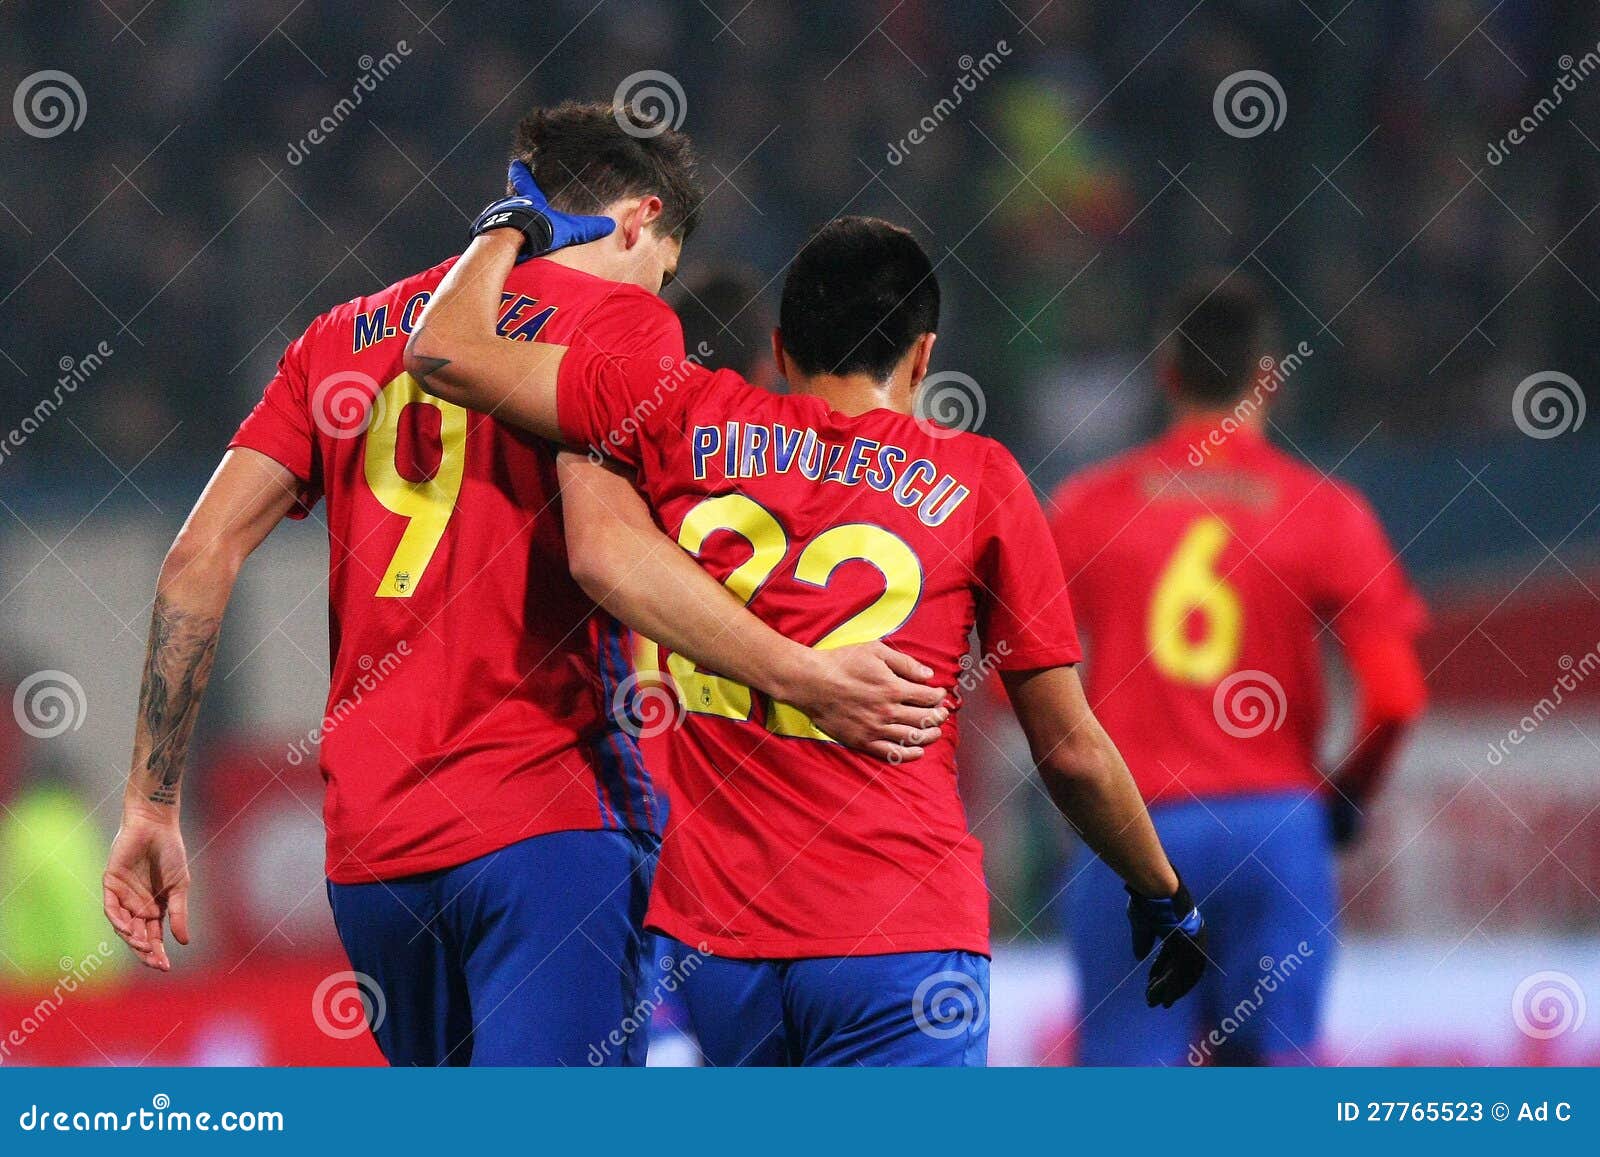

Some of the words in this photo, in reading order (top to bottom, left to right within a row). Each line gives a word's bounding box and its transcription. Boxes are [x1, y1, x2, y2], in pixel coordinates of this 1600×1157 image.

[363, 371, 468, 598] 9
[692, 421, 970, 527] PIRVULESCU
[667, 493, 924, 746] 22
[1148, 516, 1243, 684] 6
